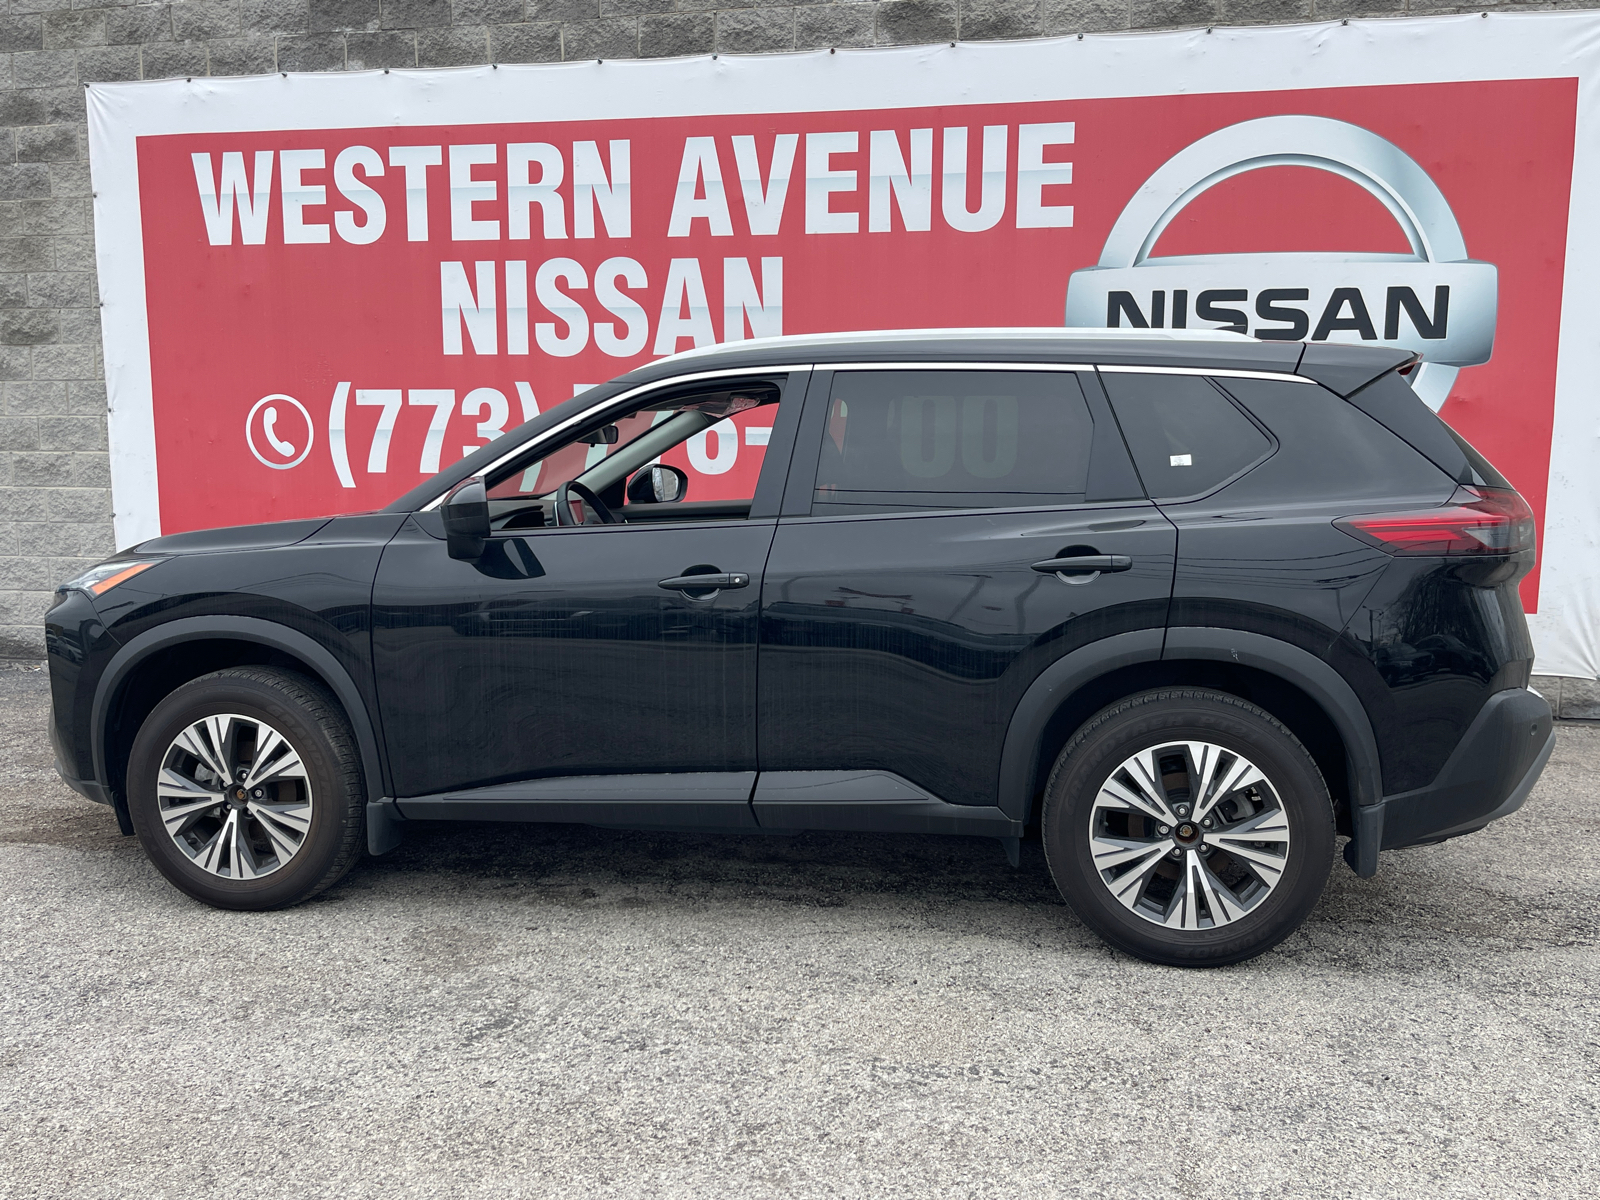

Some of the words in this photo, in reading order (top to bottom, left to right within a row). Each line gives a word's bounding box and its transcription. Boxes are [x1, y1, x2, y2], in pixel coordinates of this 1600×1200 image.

[192, 138, 632, 246] WESTERN
[668, 121, 1077, 238] AVENUE
[440, 256, 783, 357] NISSAN
[1107, 285, 1450, 341] NISSAN
[328, 381, 543, 493] (773)
